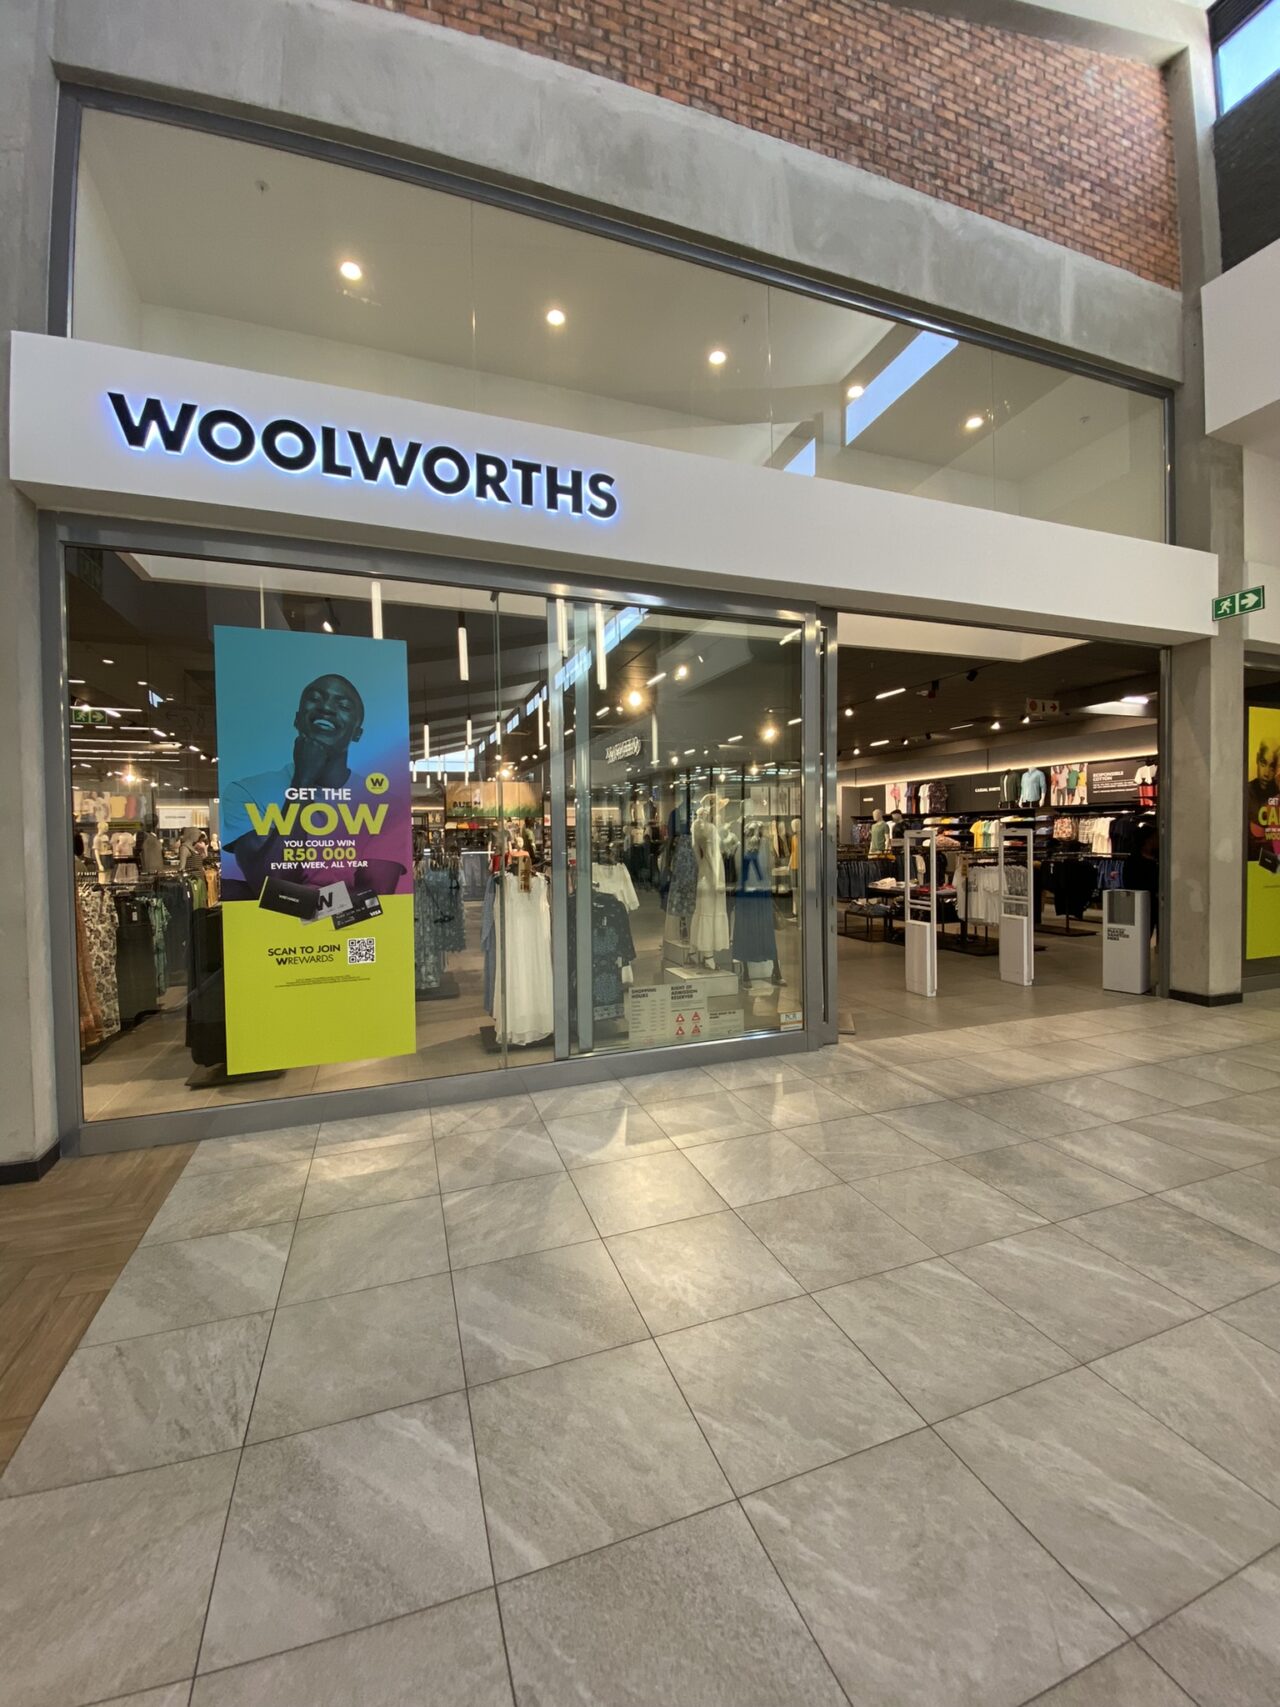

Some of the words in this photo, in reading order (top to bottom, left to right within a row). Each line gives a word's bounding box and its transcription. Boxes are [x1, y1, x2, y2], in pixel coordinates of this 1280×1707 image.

[107, 391, 618, 519] WOOLWORTHS
[370, 777, 385, 787] W
[284, 787, 317, 801] GET
[322, 788, 352, 801] THE
[1267, 797, 1279, 806] GET
[244, 802, 389, 836] WOW
[1258, 806, 1280, 826] CA
[284, 839, 304, 848] YOU
[305, 839, 335, 848] COULD
[337, 839, 356, 847] WIN
[283, 847, 318, 862] R50
[322, 847, 357, 861] 000
[270, 861, 299, 870] EVERY
[301, 861, 329, 870] WEEK,
[331, 860, 345, 869] ALL
[347, 860, 369, 868] YEAR
[369, 909, 382, 917] VISA
[267, 947, 297, 957] SCAN
[300, 945, 314, 955] TO
[318, 944, 341, 954] JOIN
[276, 954, 334, 966] WREWARDS
